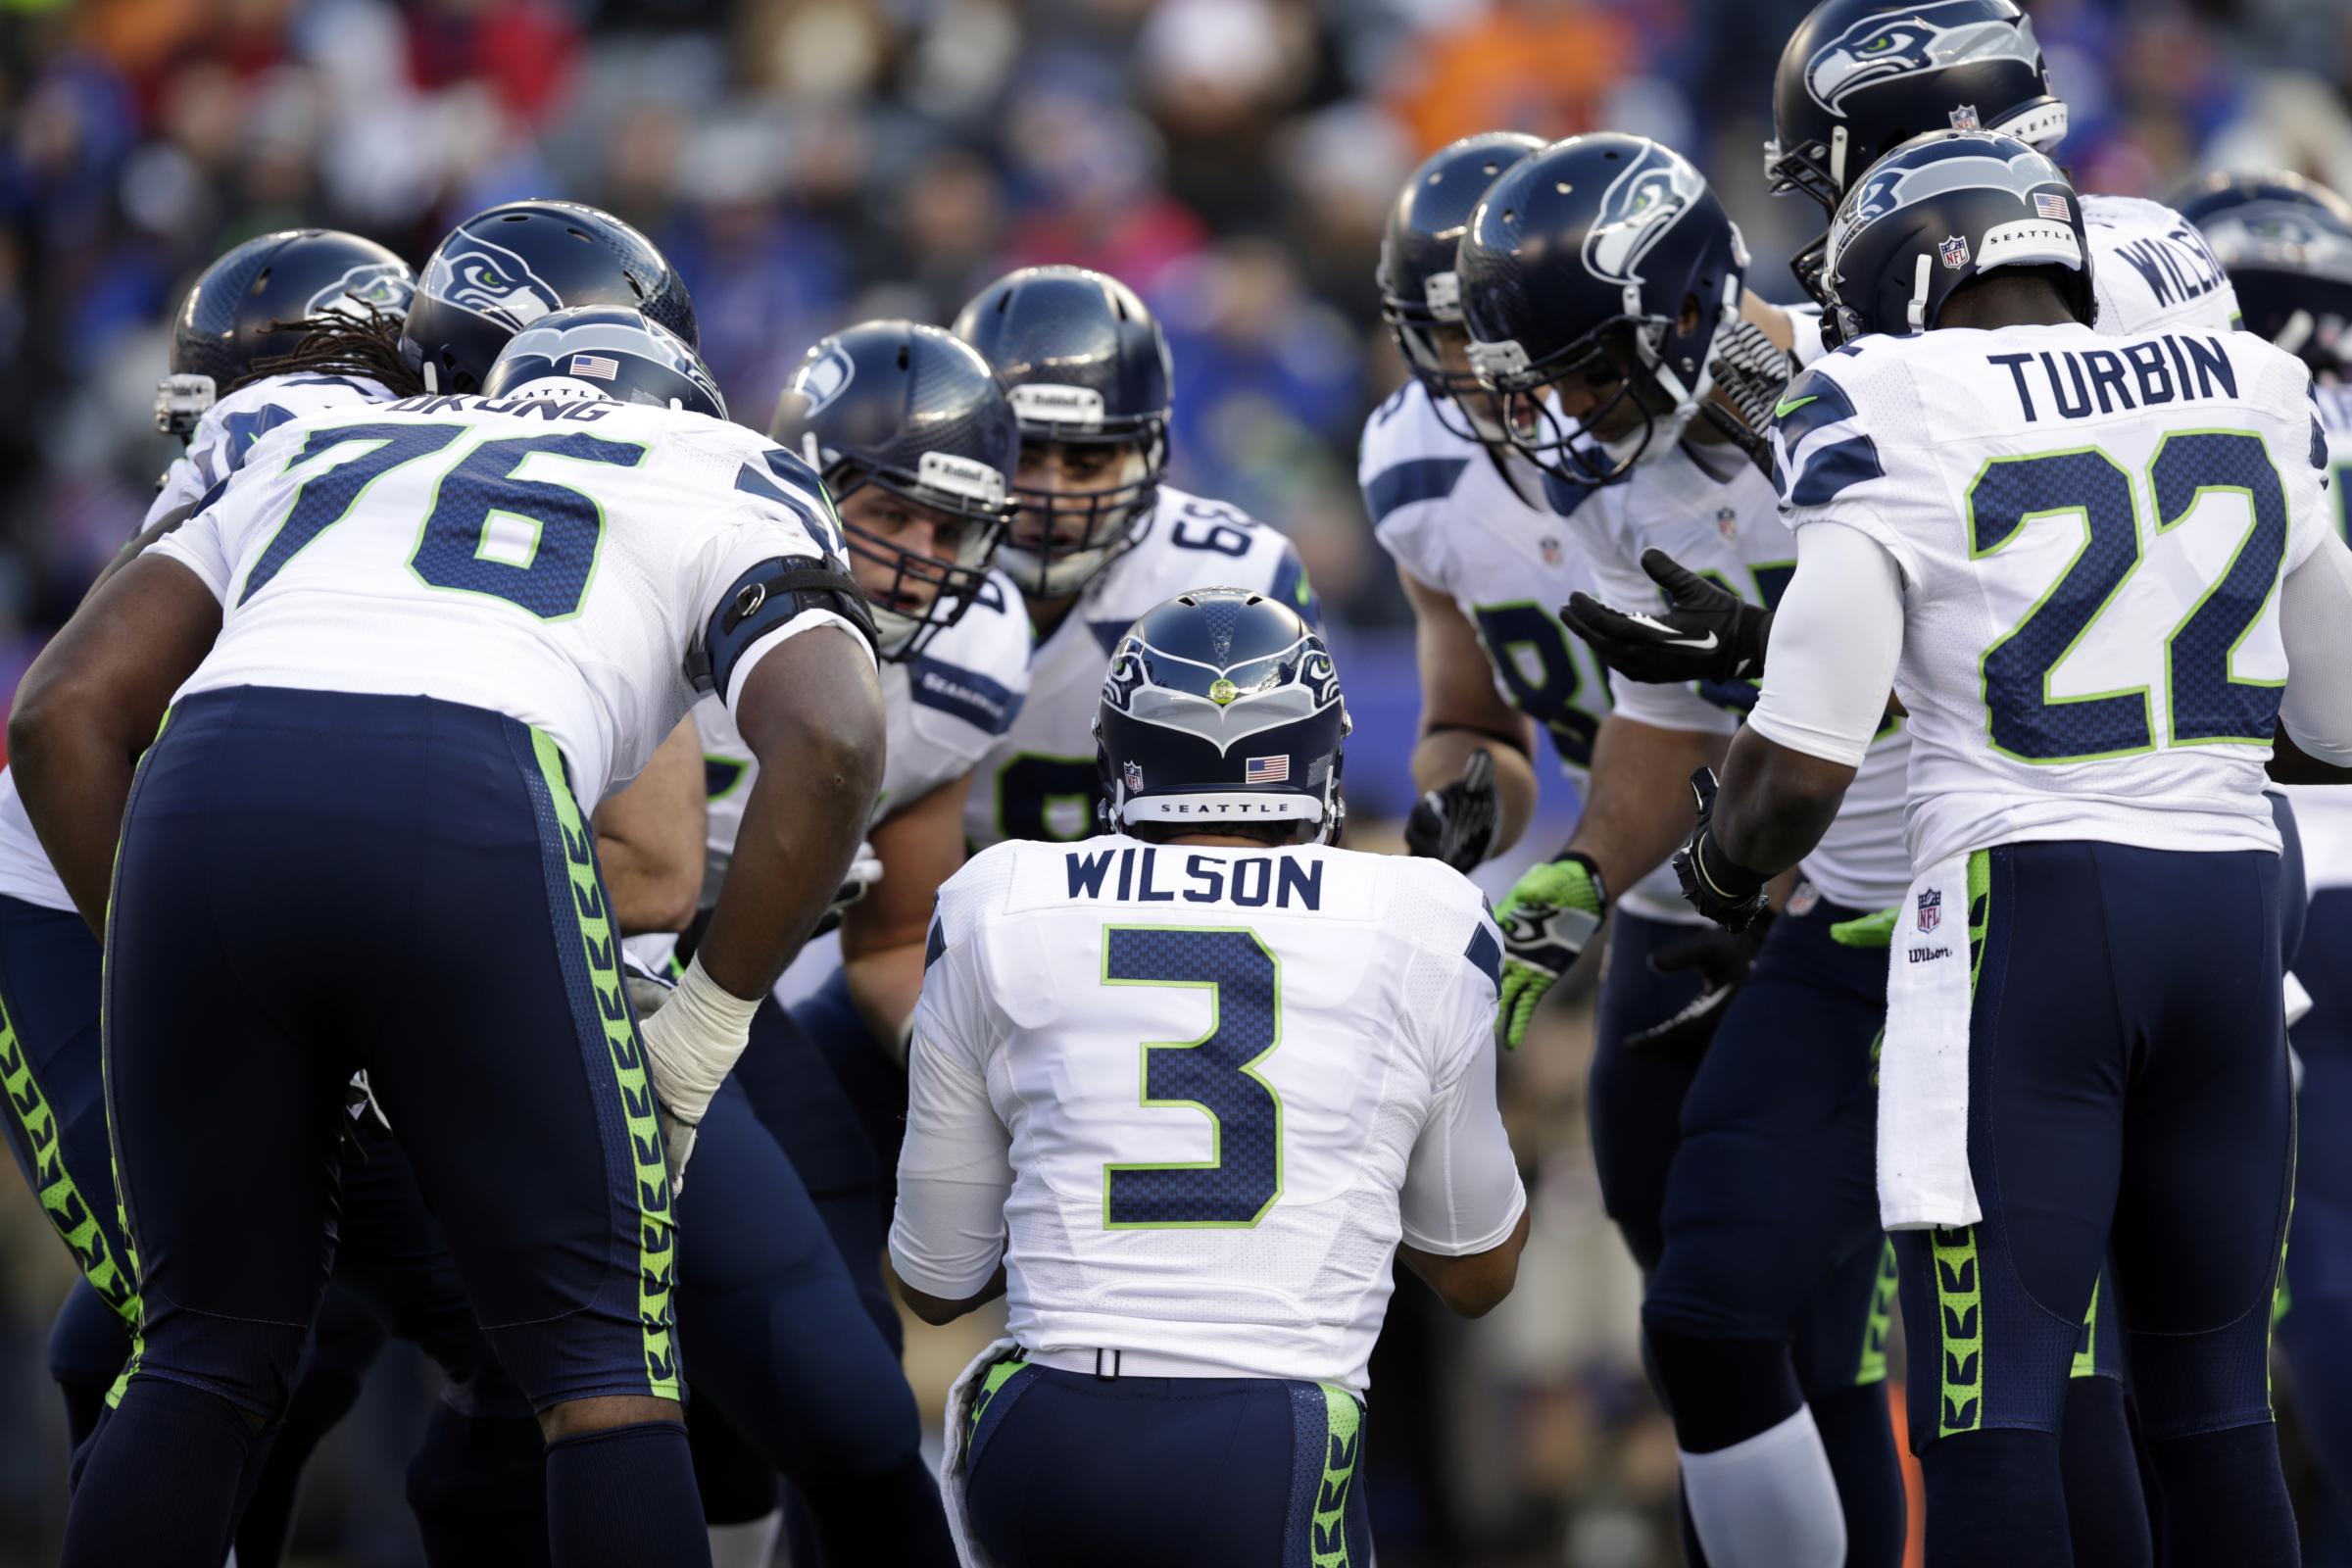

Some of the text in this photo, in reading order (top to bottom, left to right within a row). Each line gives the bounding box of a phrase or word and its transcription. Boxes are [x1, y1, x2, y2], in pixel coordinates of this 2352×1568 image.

[1990, 230, 2073, 245] SEATTLE
[1986, 335, 2240, 421] TURBIN
[236, 422, 652, 622] 76
[1965, 428, 2289, 764] 22
[1161, 804, 1290, 813] SEATTLE
[1066, 848, 1323, 910] WILSON
[1919, 906, 1940, 930] NFL
[1908, 945, 1950, 963] Wilson
[1102, 923, 1283, 1231] 3
